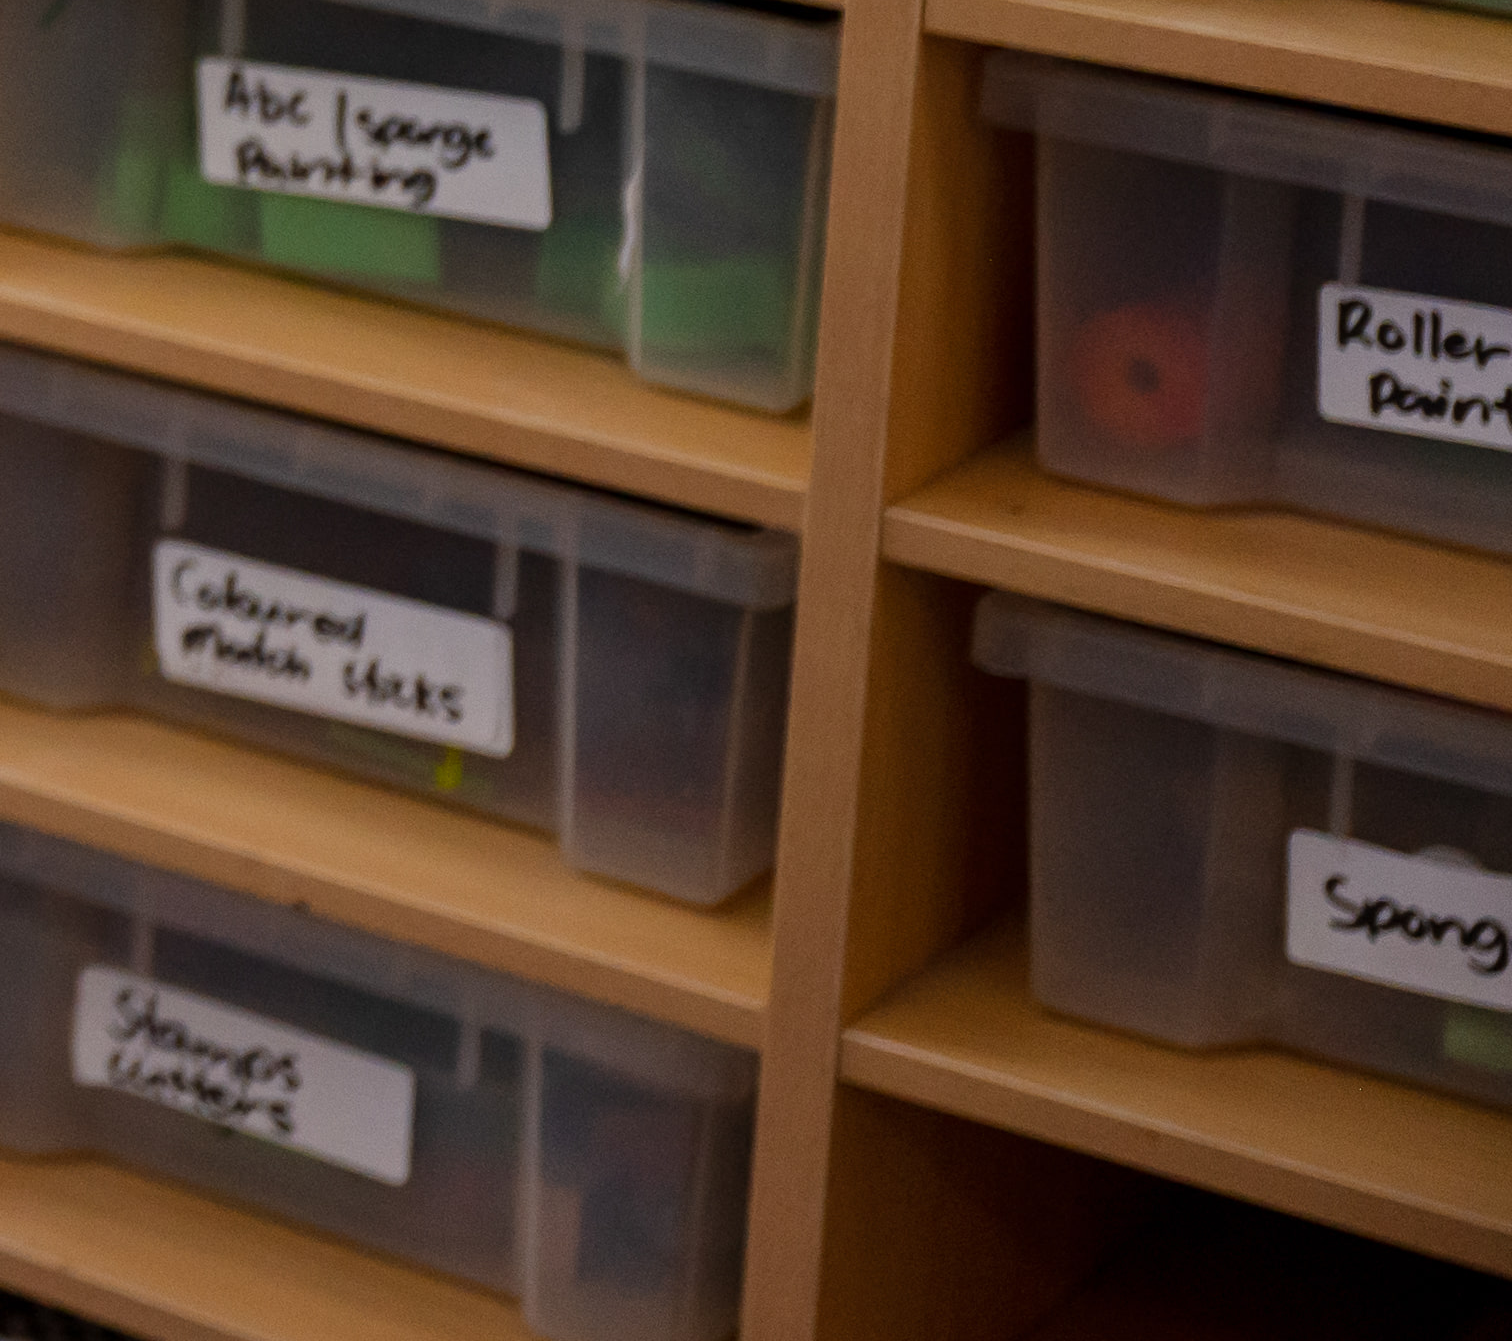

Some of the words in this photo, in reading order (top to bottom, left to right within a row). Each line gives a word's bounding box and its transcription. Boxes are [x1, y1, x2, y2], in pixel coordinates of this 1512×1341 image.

[223, 69, 311, 126] Abc
[1336, 298, 1511, 369] Roller
[1324, 873, 1509, 976] Spong
